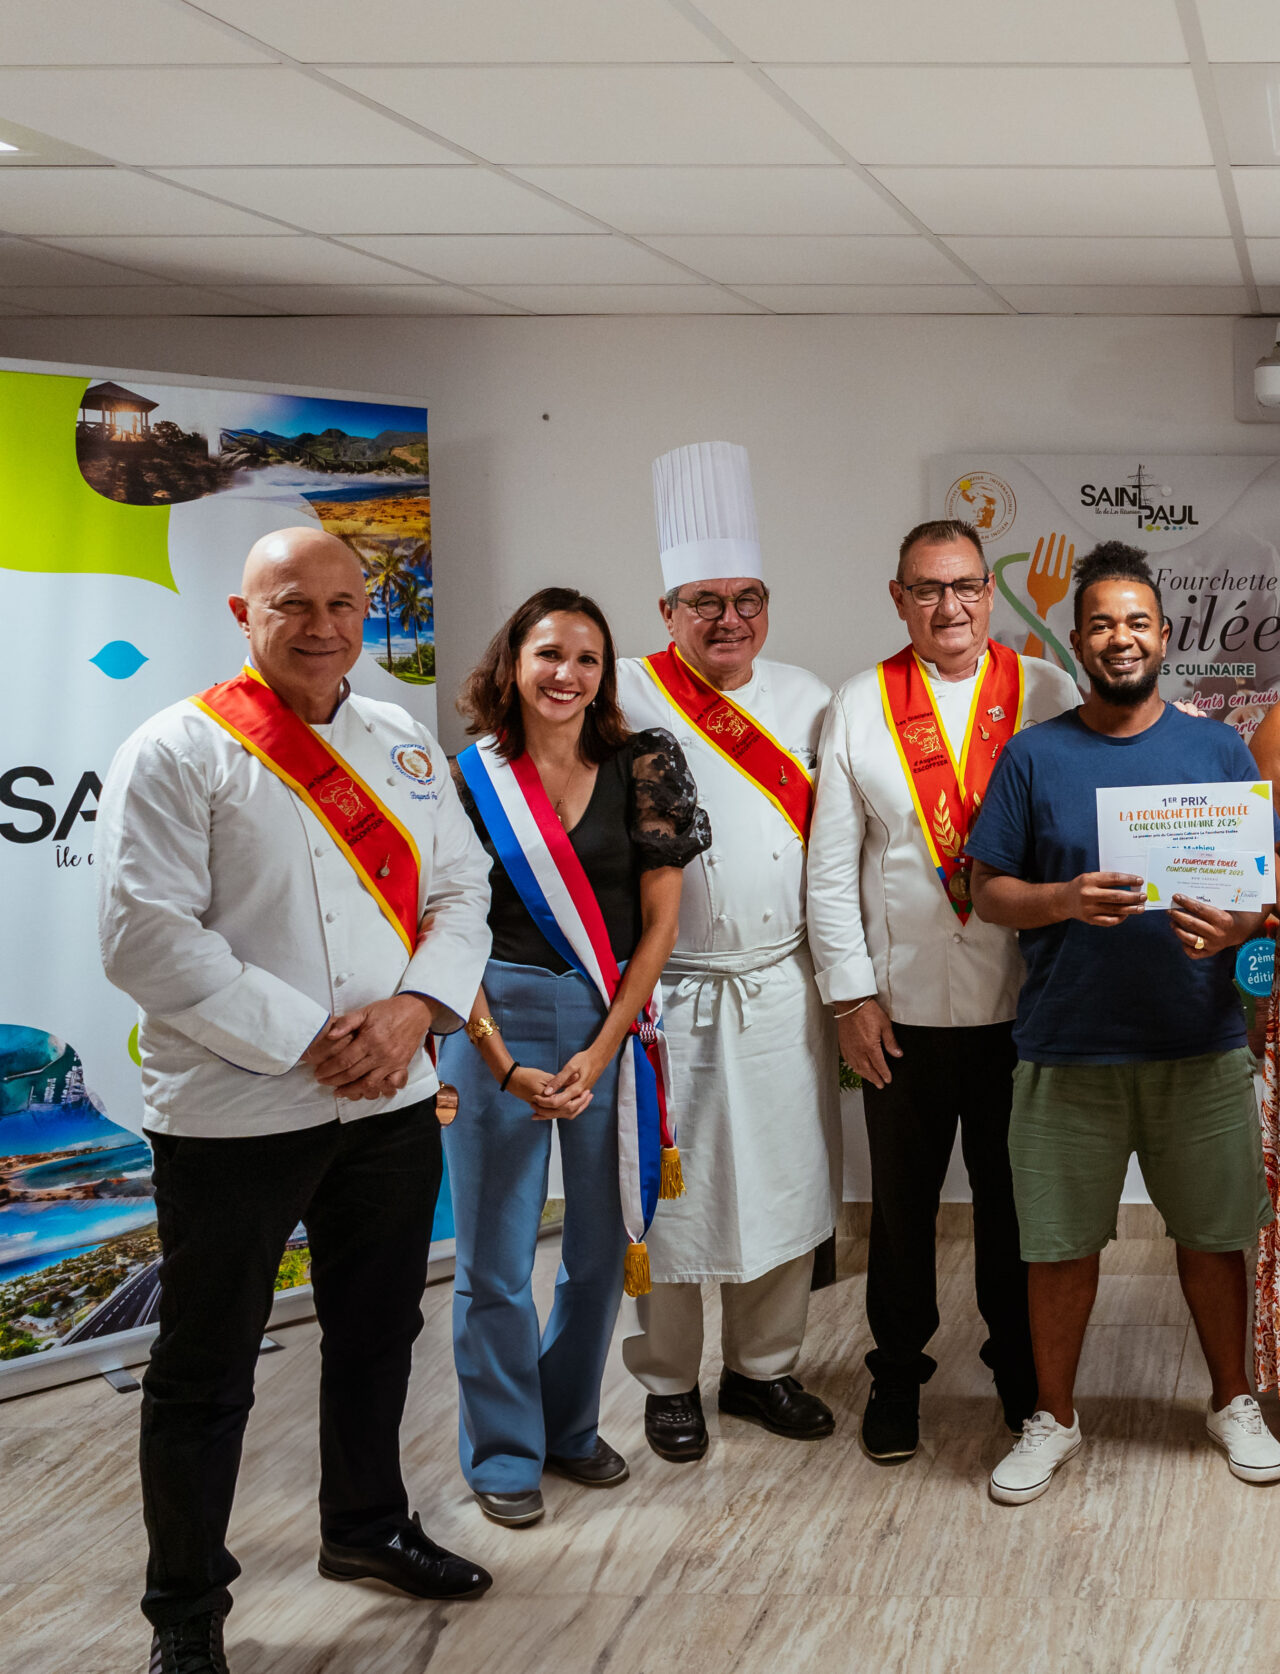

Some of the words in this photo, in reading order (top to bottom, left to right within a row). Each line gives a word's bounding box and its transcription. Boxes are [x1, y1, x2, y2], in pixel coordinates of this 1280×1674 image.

[1138, 505, 1199, 529] PAUL
[1156, 568, 1278, 591] Fourchette
[1176, 664, 1255, 676] CULINAIRE
[1230, 695, 1245, 706] en
[914, 759, 948, 774] ESCOFFIER
[1181, 796, 1208, 806] PRIX
[1119, 811, 1134, 821] LA
[1136, 807, 1205, 821] FOURCHETTE
[1208, 803, 1249, 818] ÉTOILÉE
[1129, 821, 1172, 832] CONCOURS
[1173, 819, 1215, 830] CULINAIRE
[1217, 818, 1237, 828] 2025
[1247, 970, 1275, 985] éditi
